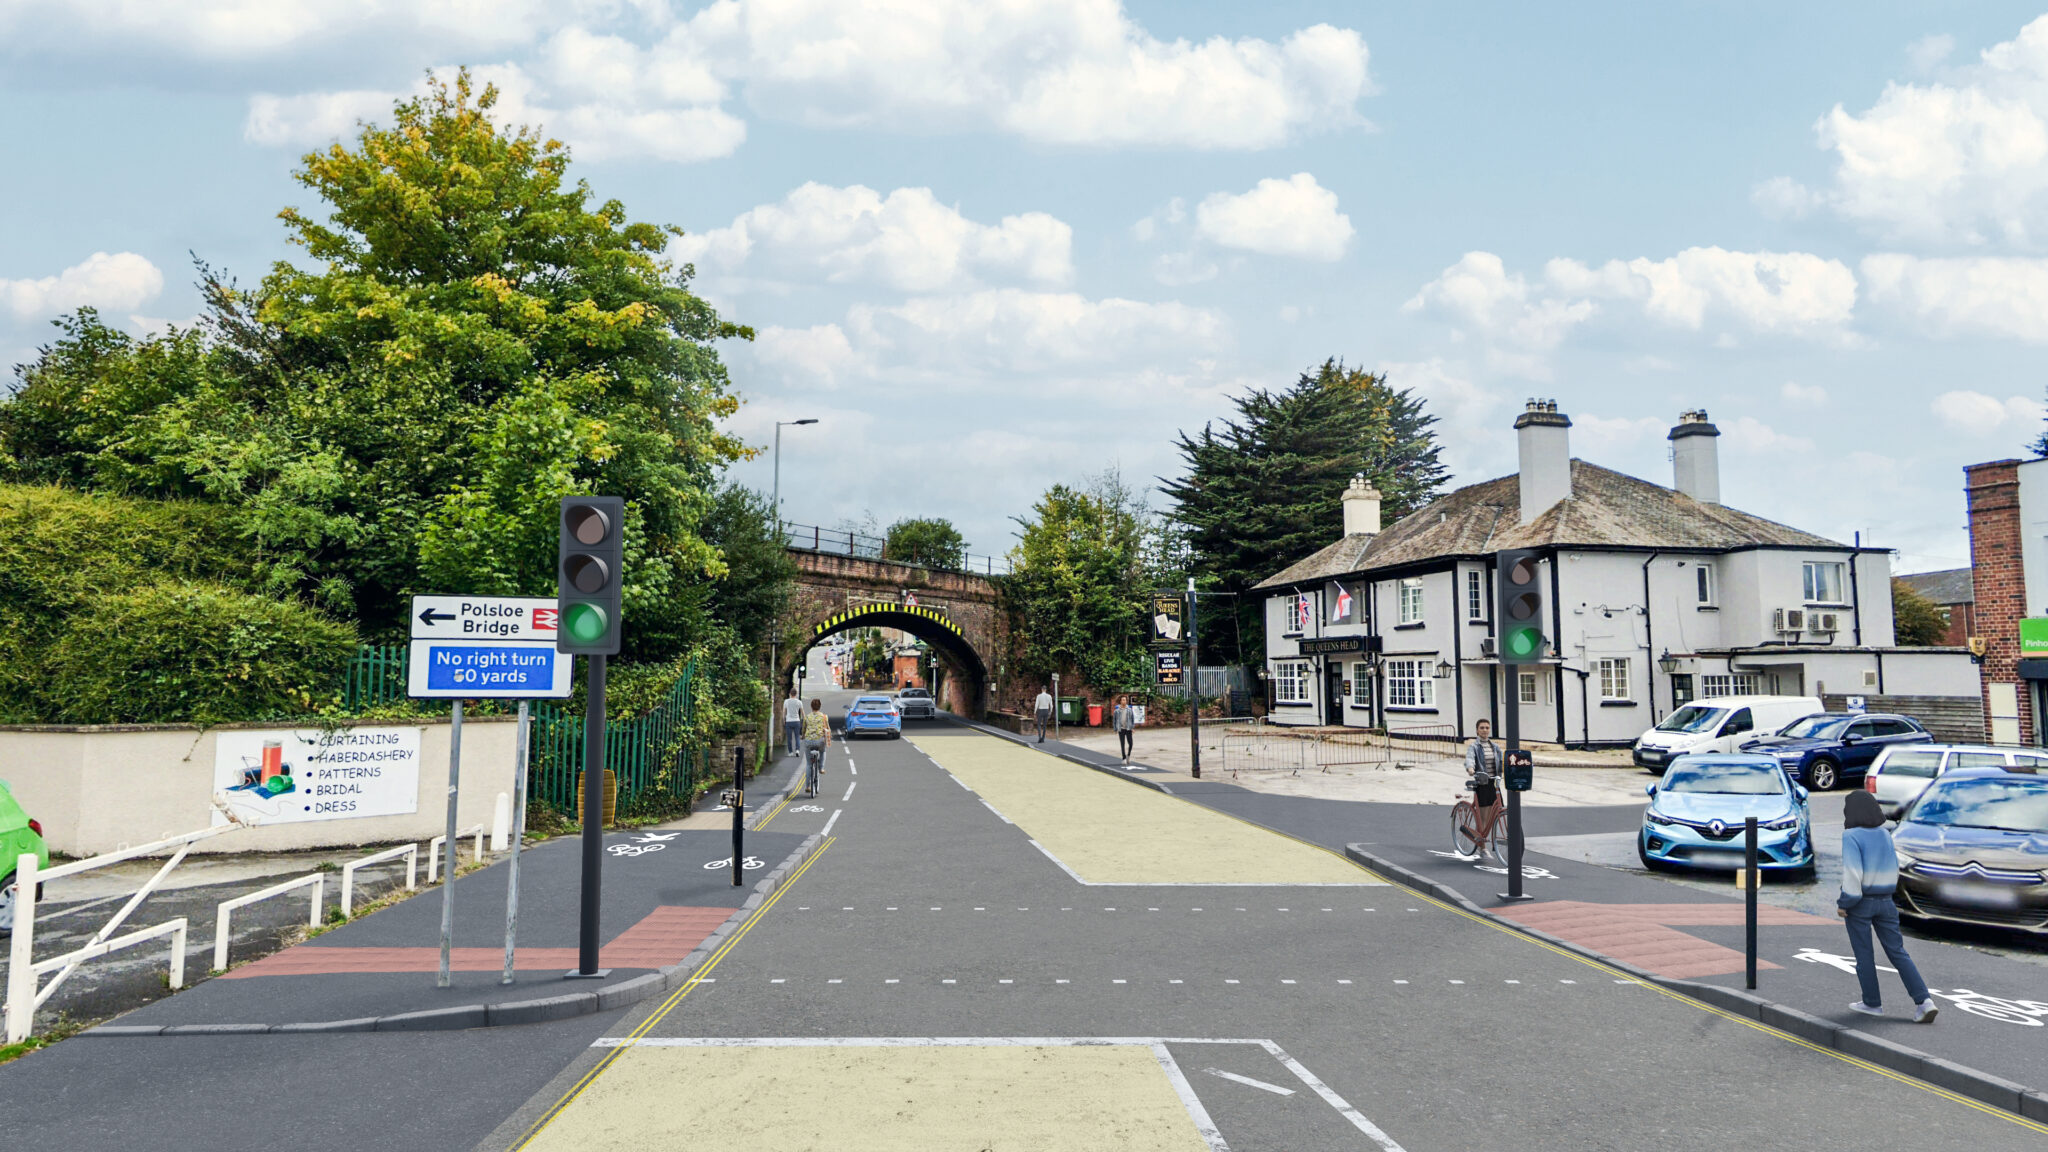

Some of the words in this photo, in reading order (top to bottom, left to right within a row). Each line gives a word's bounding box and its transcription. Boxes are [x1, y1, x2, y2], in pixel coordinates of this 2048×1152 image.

[461, 602, 524, 617] Polsloe
[463, 620, 520, 636] Bridge
[1304, 643, 1315, 652] THE
[1316, 641, 1340, 653] QUEENS
[1341, 640, 1359, 650] HEAD
[437, 651, 462, 666] No
[467, 651, 507, 669] right
[511, 652, 547, 666] turn
[453, 669, 478, 683] 50
[481, 669, 528, 685] yards
[319, 733, 400, 747] CURTAINING
[318, 749, 414, 763] HABERDASHERY
[318, 767, 382, 780] PATTERNS
[316, 783, 363, 796] BRIDAL
[315, 800, 357, 814] DRESS
